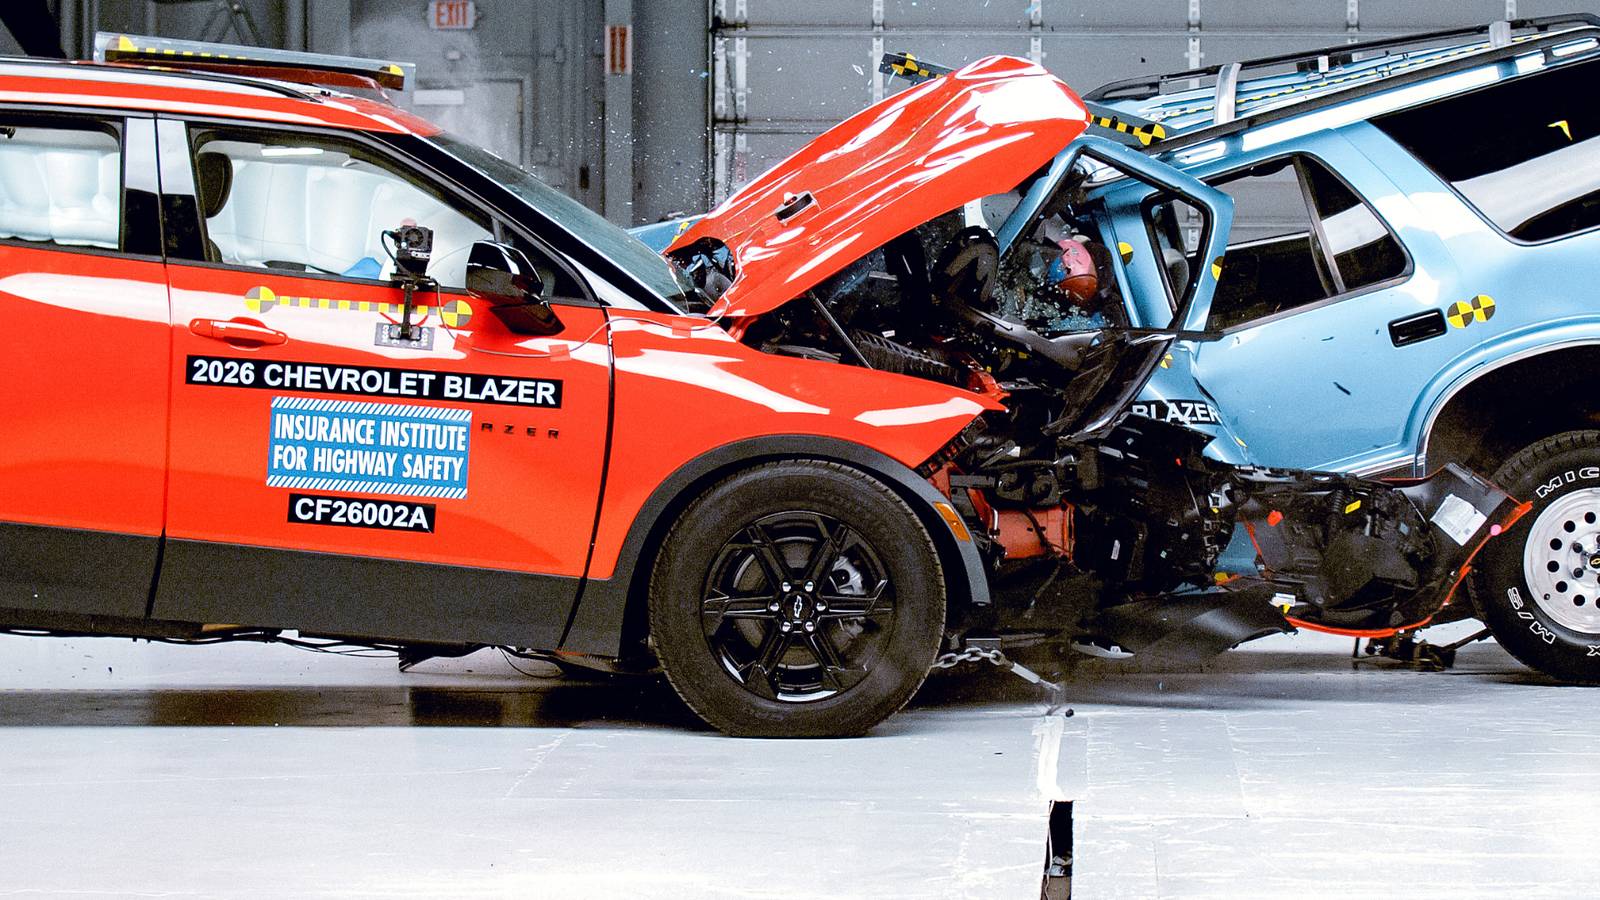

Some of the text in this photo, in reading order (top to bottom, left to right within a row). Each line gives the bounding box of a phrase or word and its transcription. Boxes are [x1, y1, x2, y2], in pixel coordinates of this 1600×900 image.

[436, 1, 468, 27] EXIT
[192, 359, 556, 405] 2026 CHEVROLET BLAZER
[1132, 402, 1222, 422] BLAZER
[274, 413, 467, 452] INSURANCE INSTITUTE
[273, 445, 464, 482] FOR HIGHWAY SAFETY
[1536, 466, 1600, 498] MIC
[295, 498, 429, 529] CF26002A
